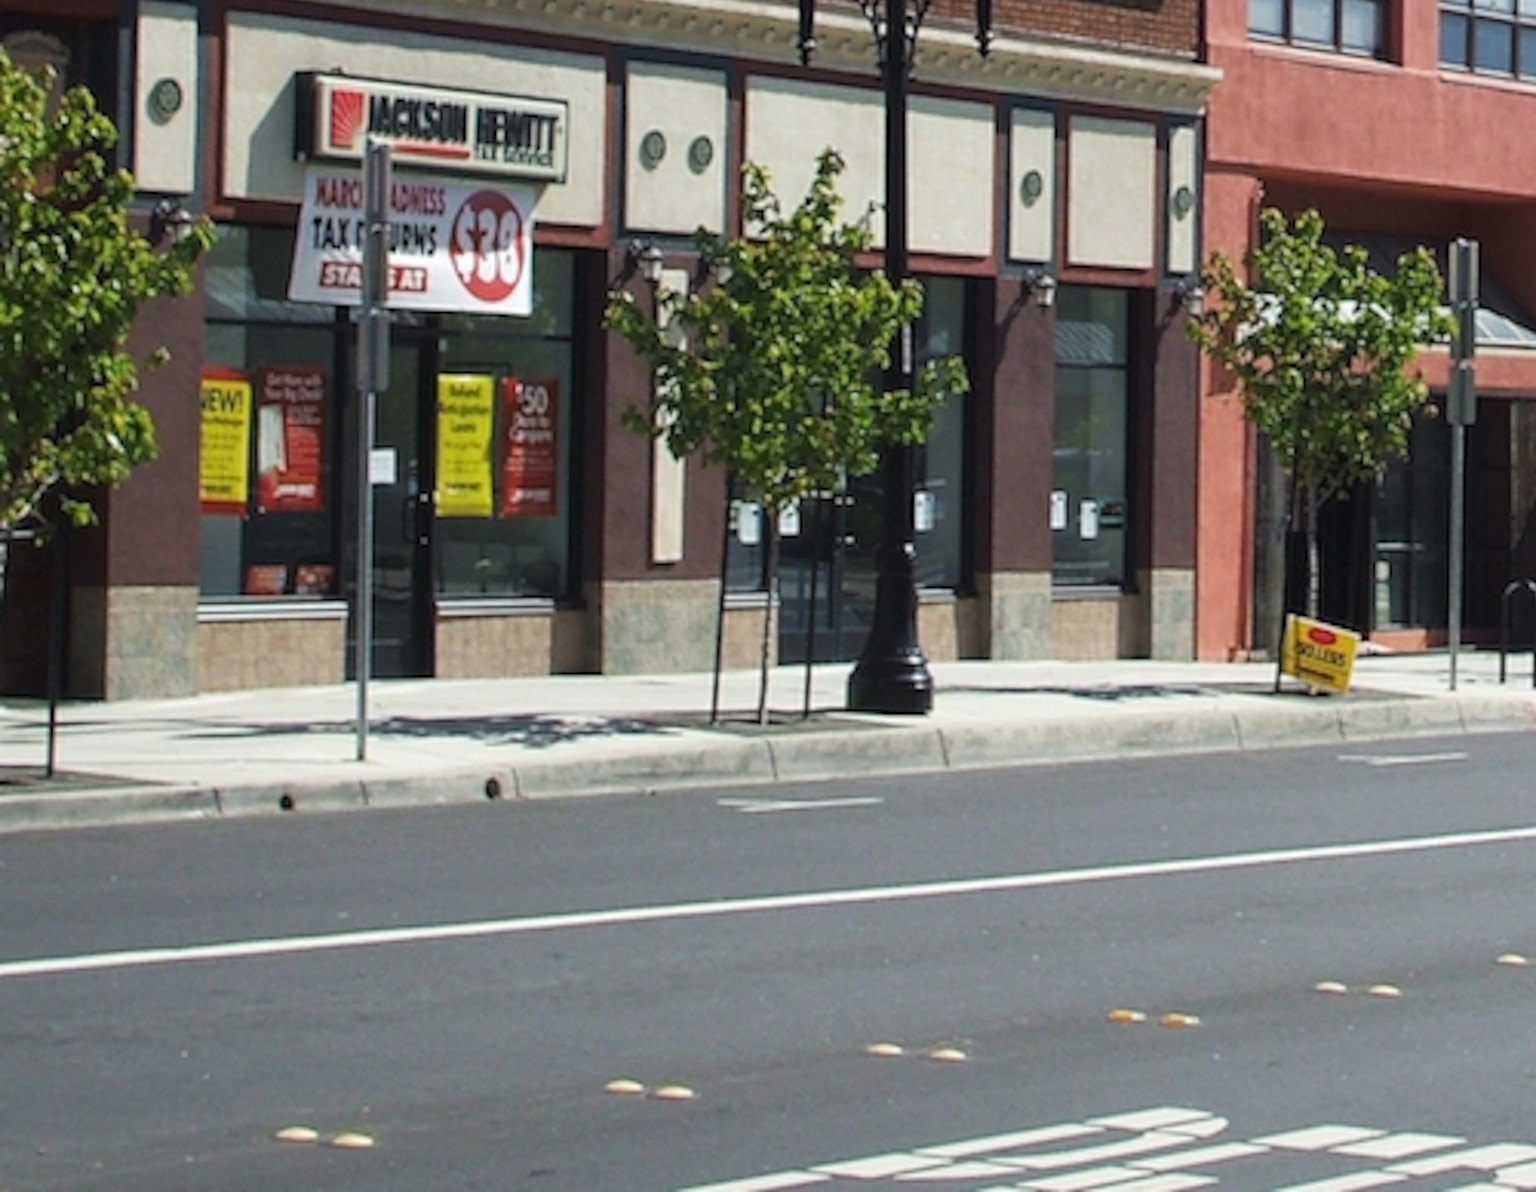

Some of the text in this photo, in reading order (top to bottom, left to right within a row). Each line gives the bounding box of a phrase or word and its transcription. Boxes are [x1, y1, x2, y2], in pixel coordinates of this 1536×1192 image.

[369, 94, 559, 153] JACKSON HEWITT
[315, 177, 446, 216] MARC ADNESS
[311, 216, 438, 257] TAX RURNS
[323, 264, 425, 290] STAS AT
